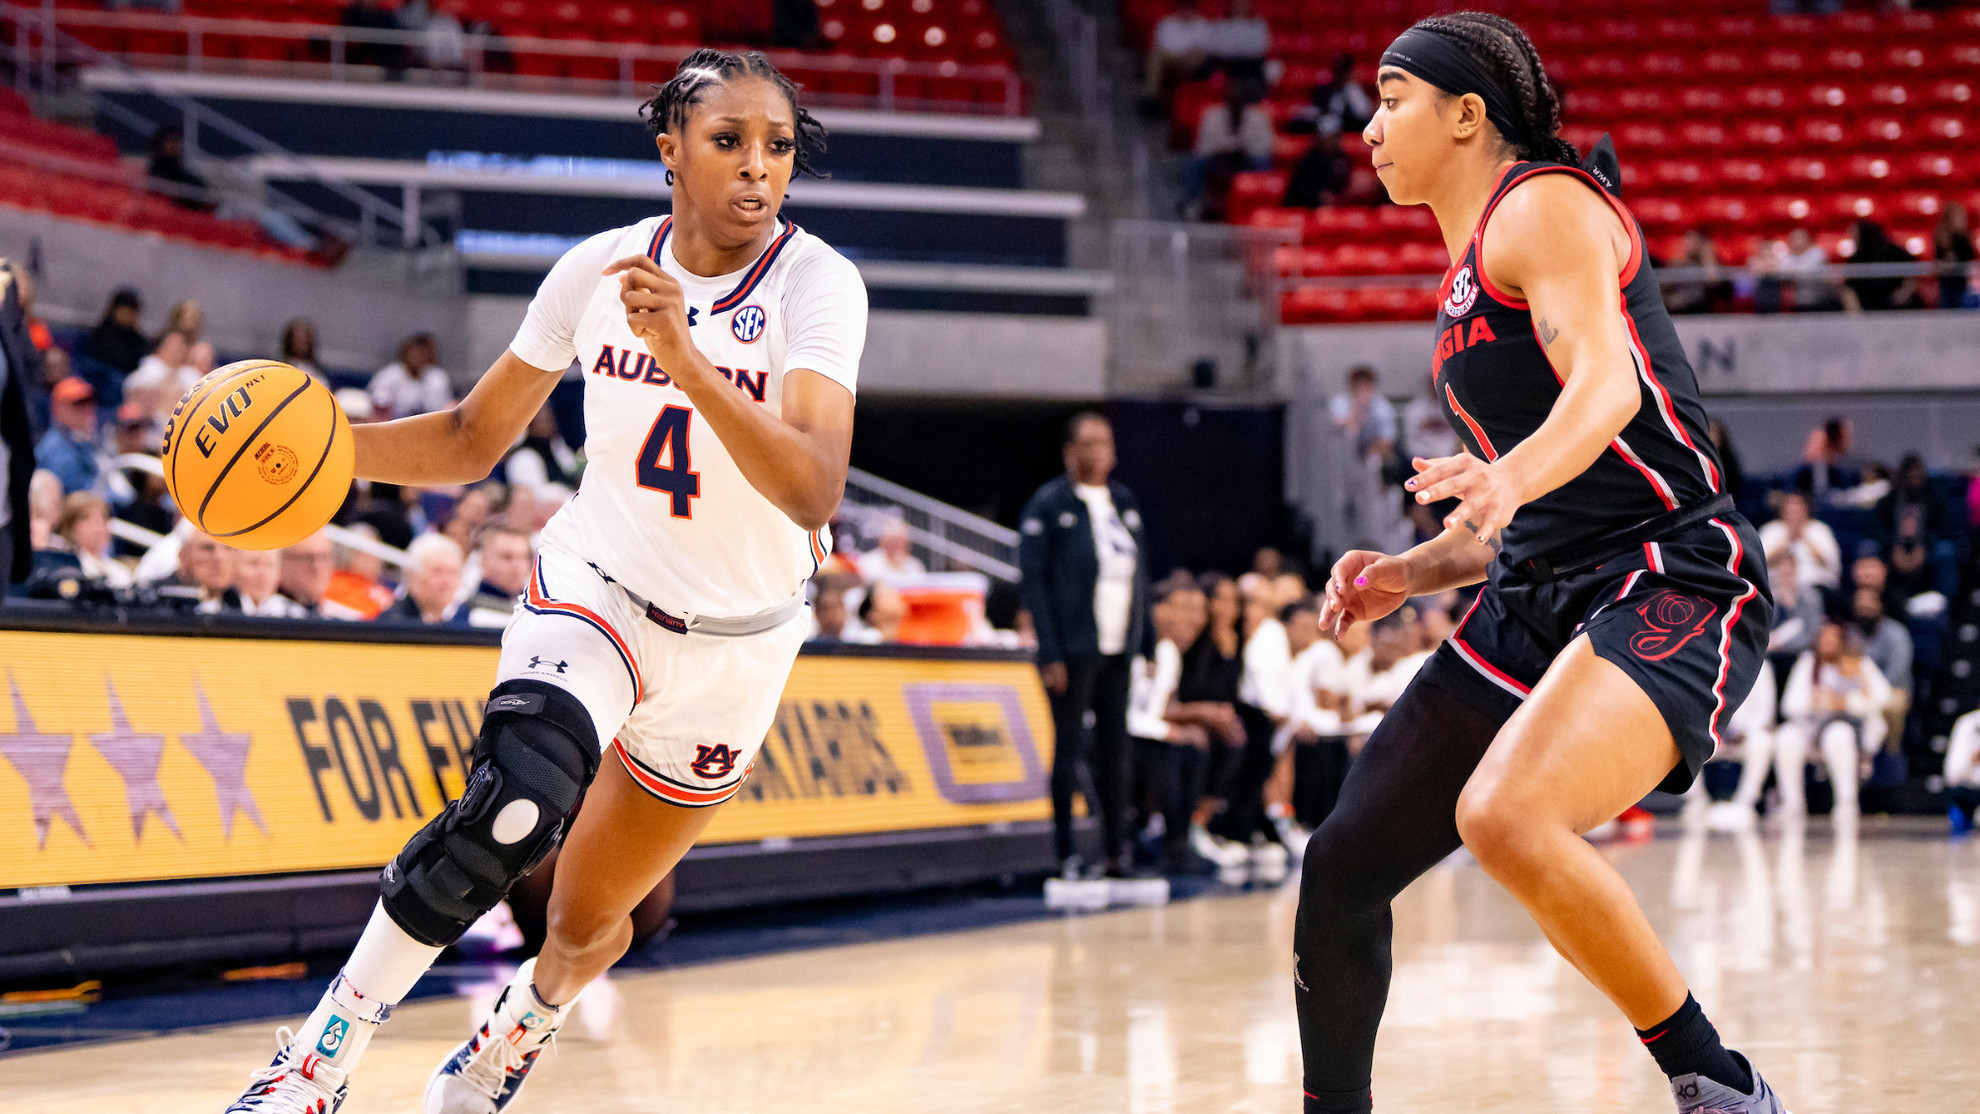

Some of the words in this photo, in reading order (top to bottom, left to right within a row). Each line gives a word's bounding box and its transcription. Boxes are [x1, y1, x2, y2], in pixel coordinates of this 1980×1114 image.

[1451, 266, 1472, 304] SEC
[733, 307, 765, 341] SEC
[592, 344, 769, 403] AUBN
[635, 403, 700, 520] 4
[285, 696, 424, 822] FOR
